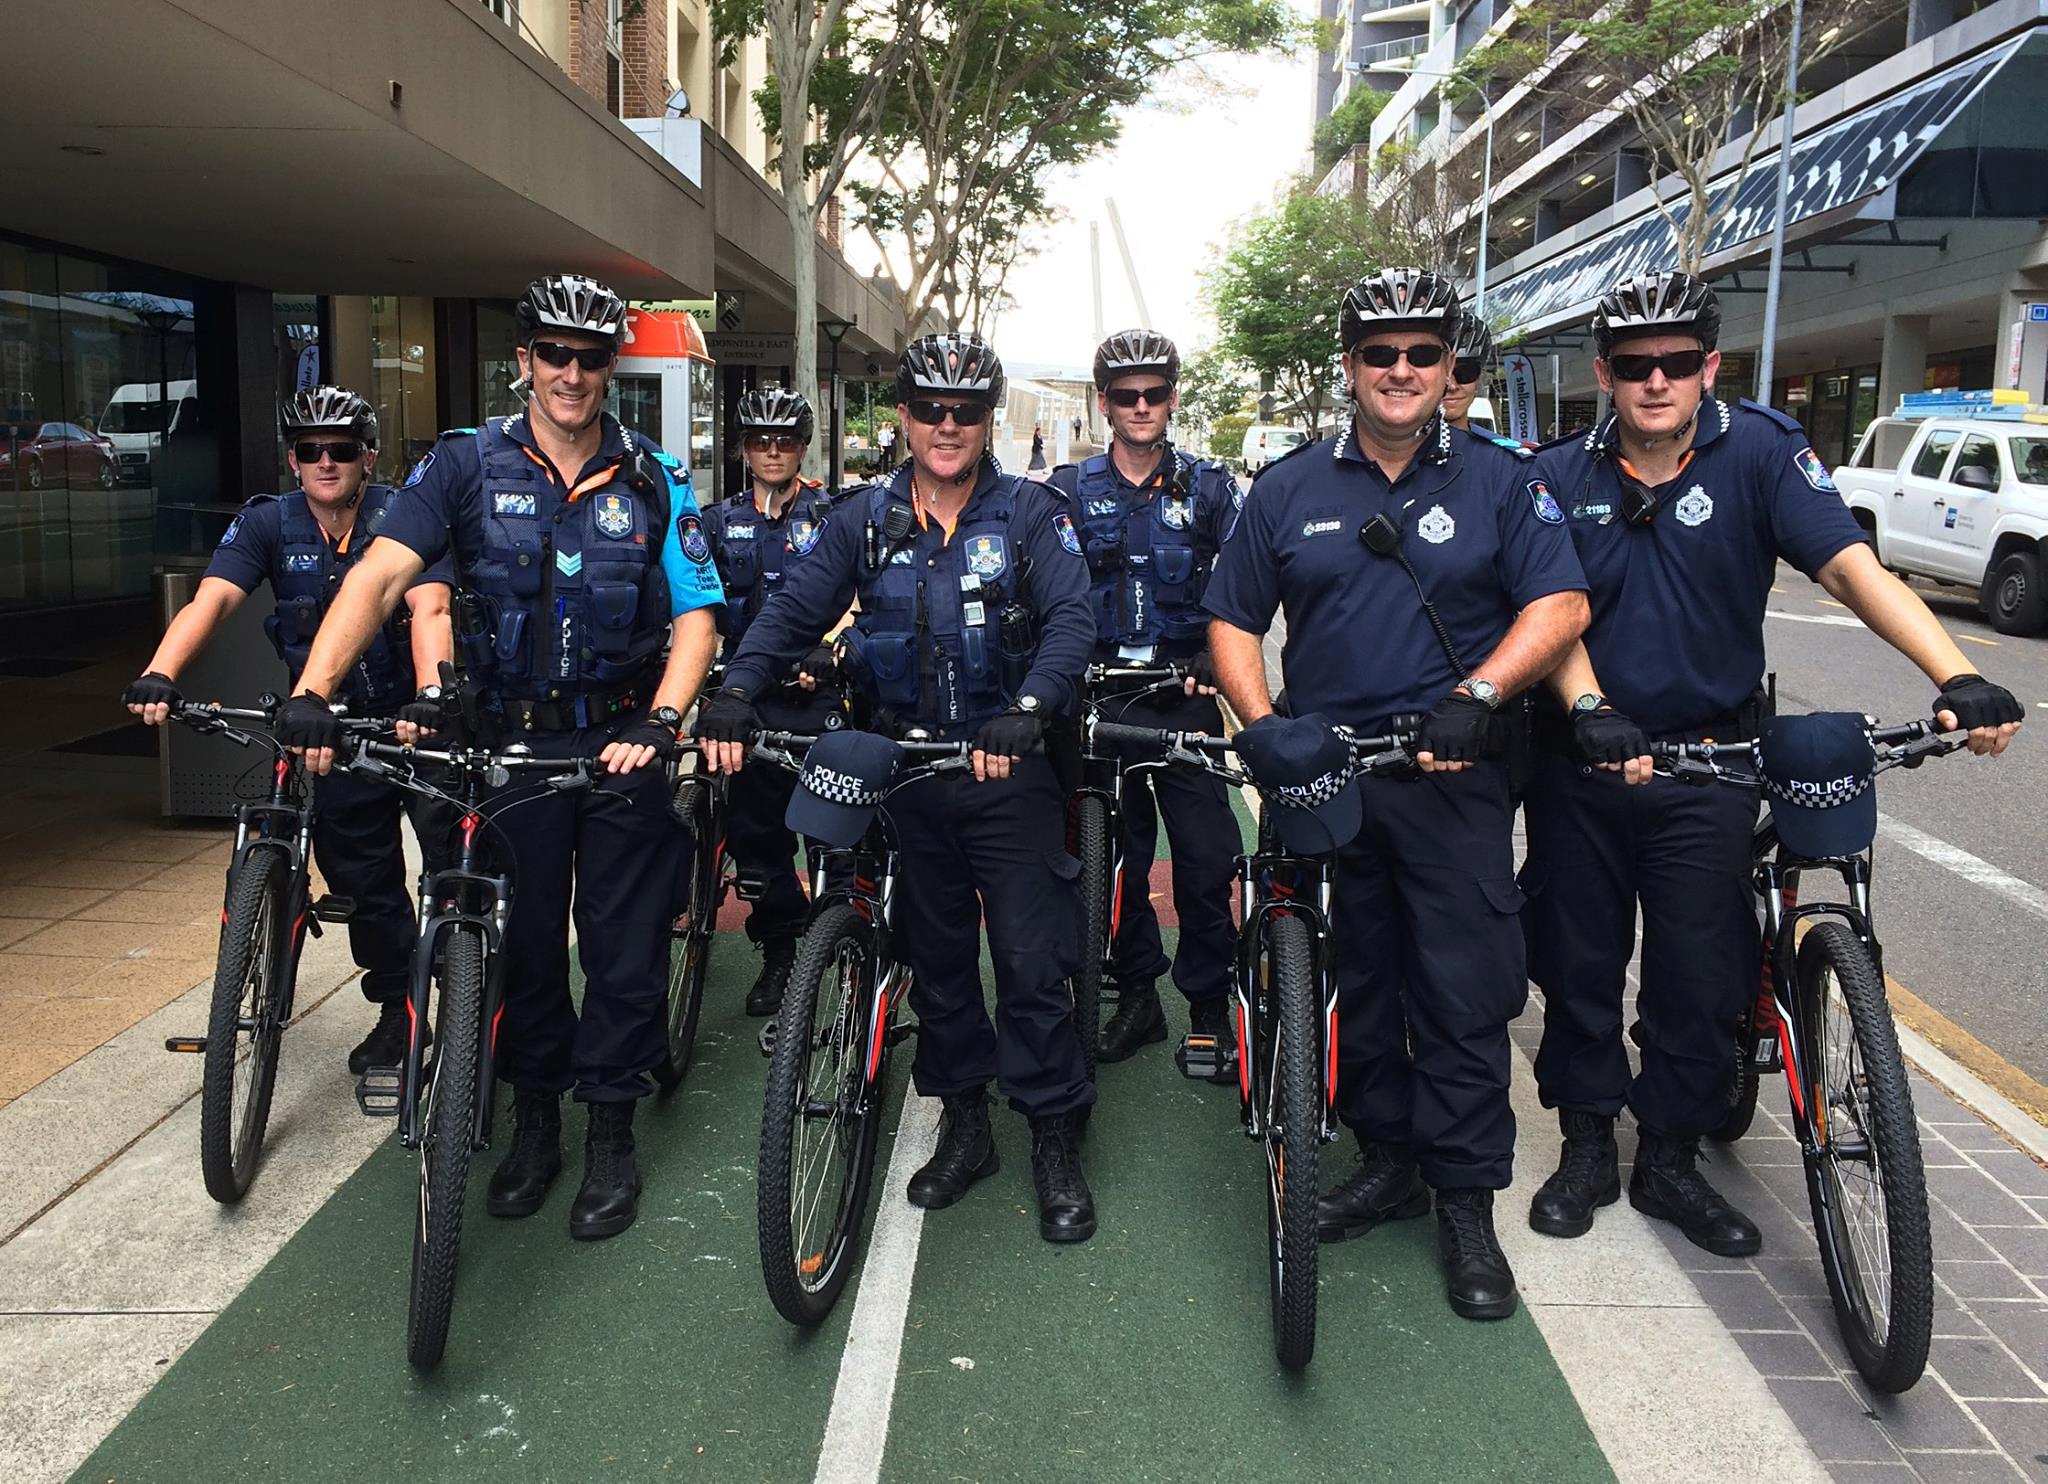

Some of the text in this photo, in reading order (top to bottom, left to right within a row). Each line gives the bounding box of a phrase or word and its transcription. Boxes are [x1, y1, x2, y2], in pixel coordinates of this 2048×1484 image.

[711, 339, 756, 348] DONNELL
[1516, 376, 1530, 438] stellarossa
[1135, 581, 1144, 630] POLICE
[560, 617, 571, 677] POLICE
[360, 655, 375, 697] OLICE
[947, 661, 958, 720] POLICE
[814, 764, 864, 791] POLICE
[1280, 771, 1334, 797] POLICE
[1790, 775, 1854, 795] POLICE
